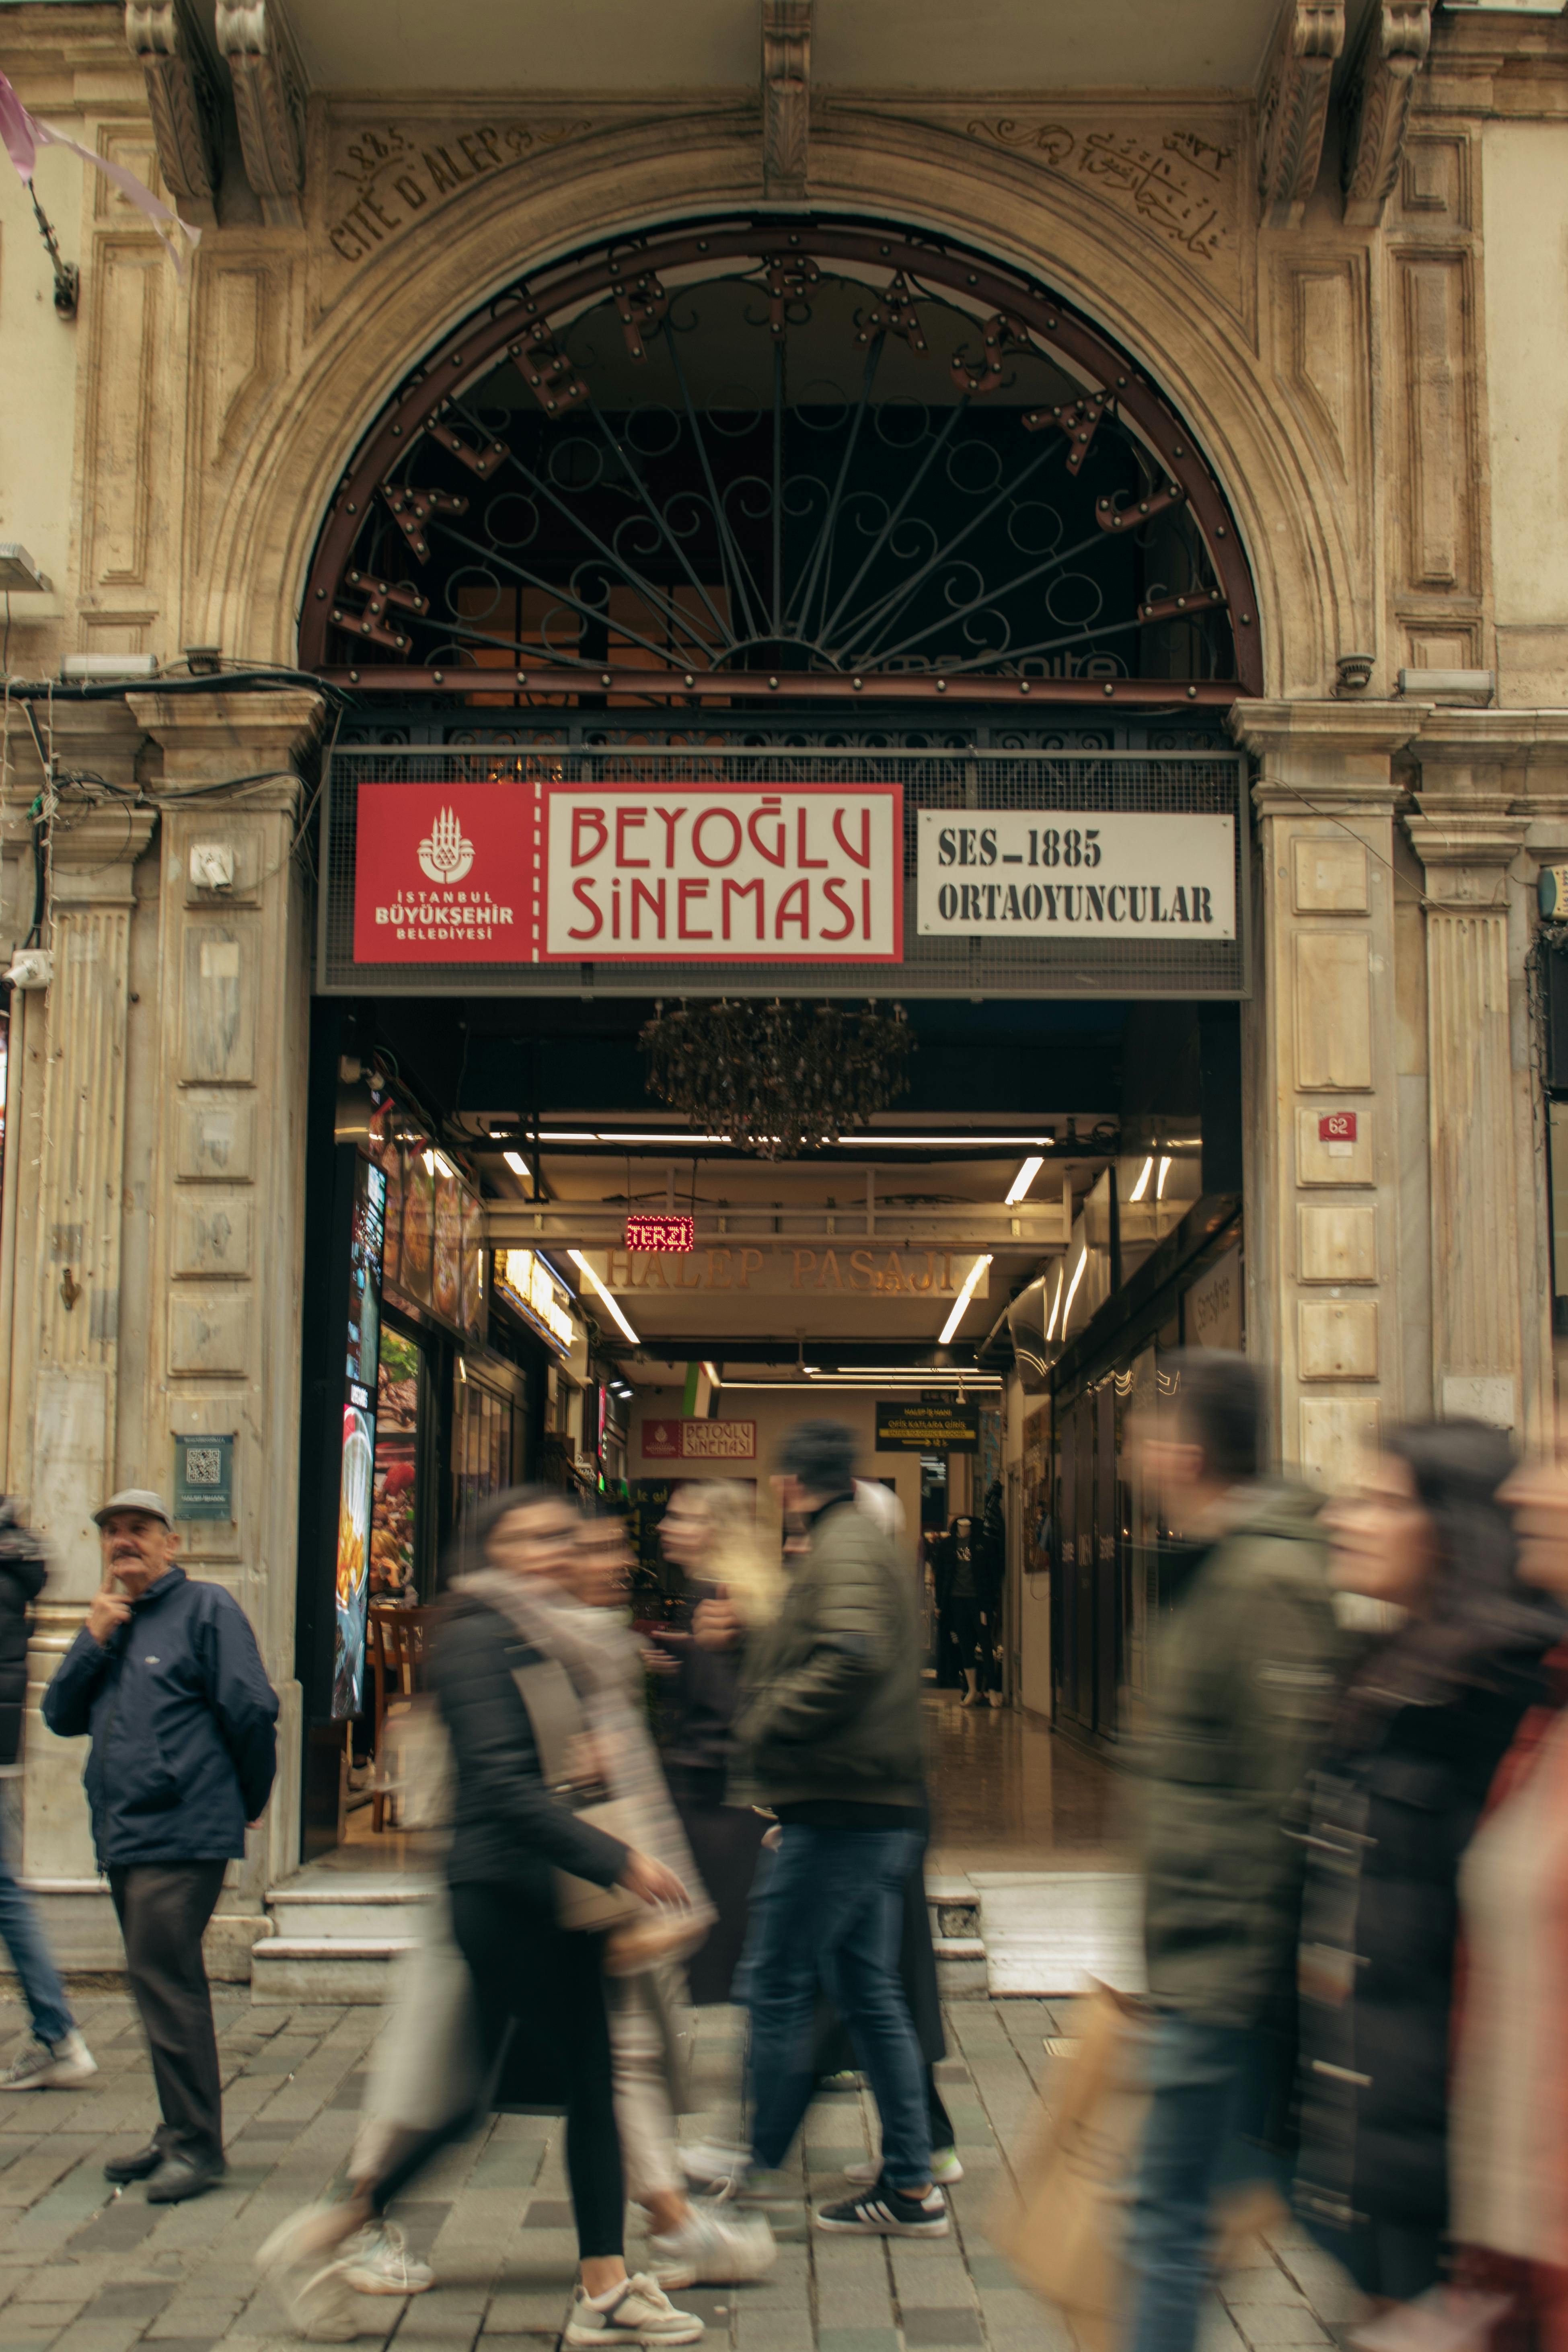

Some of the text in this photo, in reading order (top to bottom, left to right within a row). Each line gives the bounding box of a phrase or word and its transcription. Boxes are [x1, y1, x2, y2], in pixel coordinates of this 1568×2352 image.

[571, 796, 871, 868] BEYOĞLU
[398, 889, 493, 904] İSTANBUL
[938, 882, 1213, 923] ORTAOYUNCULAR
[375, 904, 514, 926] BÜYÜKŞEHİR
[396, 925, 493, 940] BELEDİYESİ
[1329, 1118, 1348, 1134] 62
[628, 1223, 687, 1246] TERZİ
[605, 1248, 956, 1291] HALEP PASAJI
